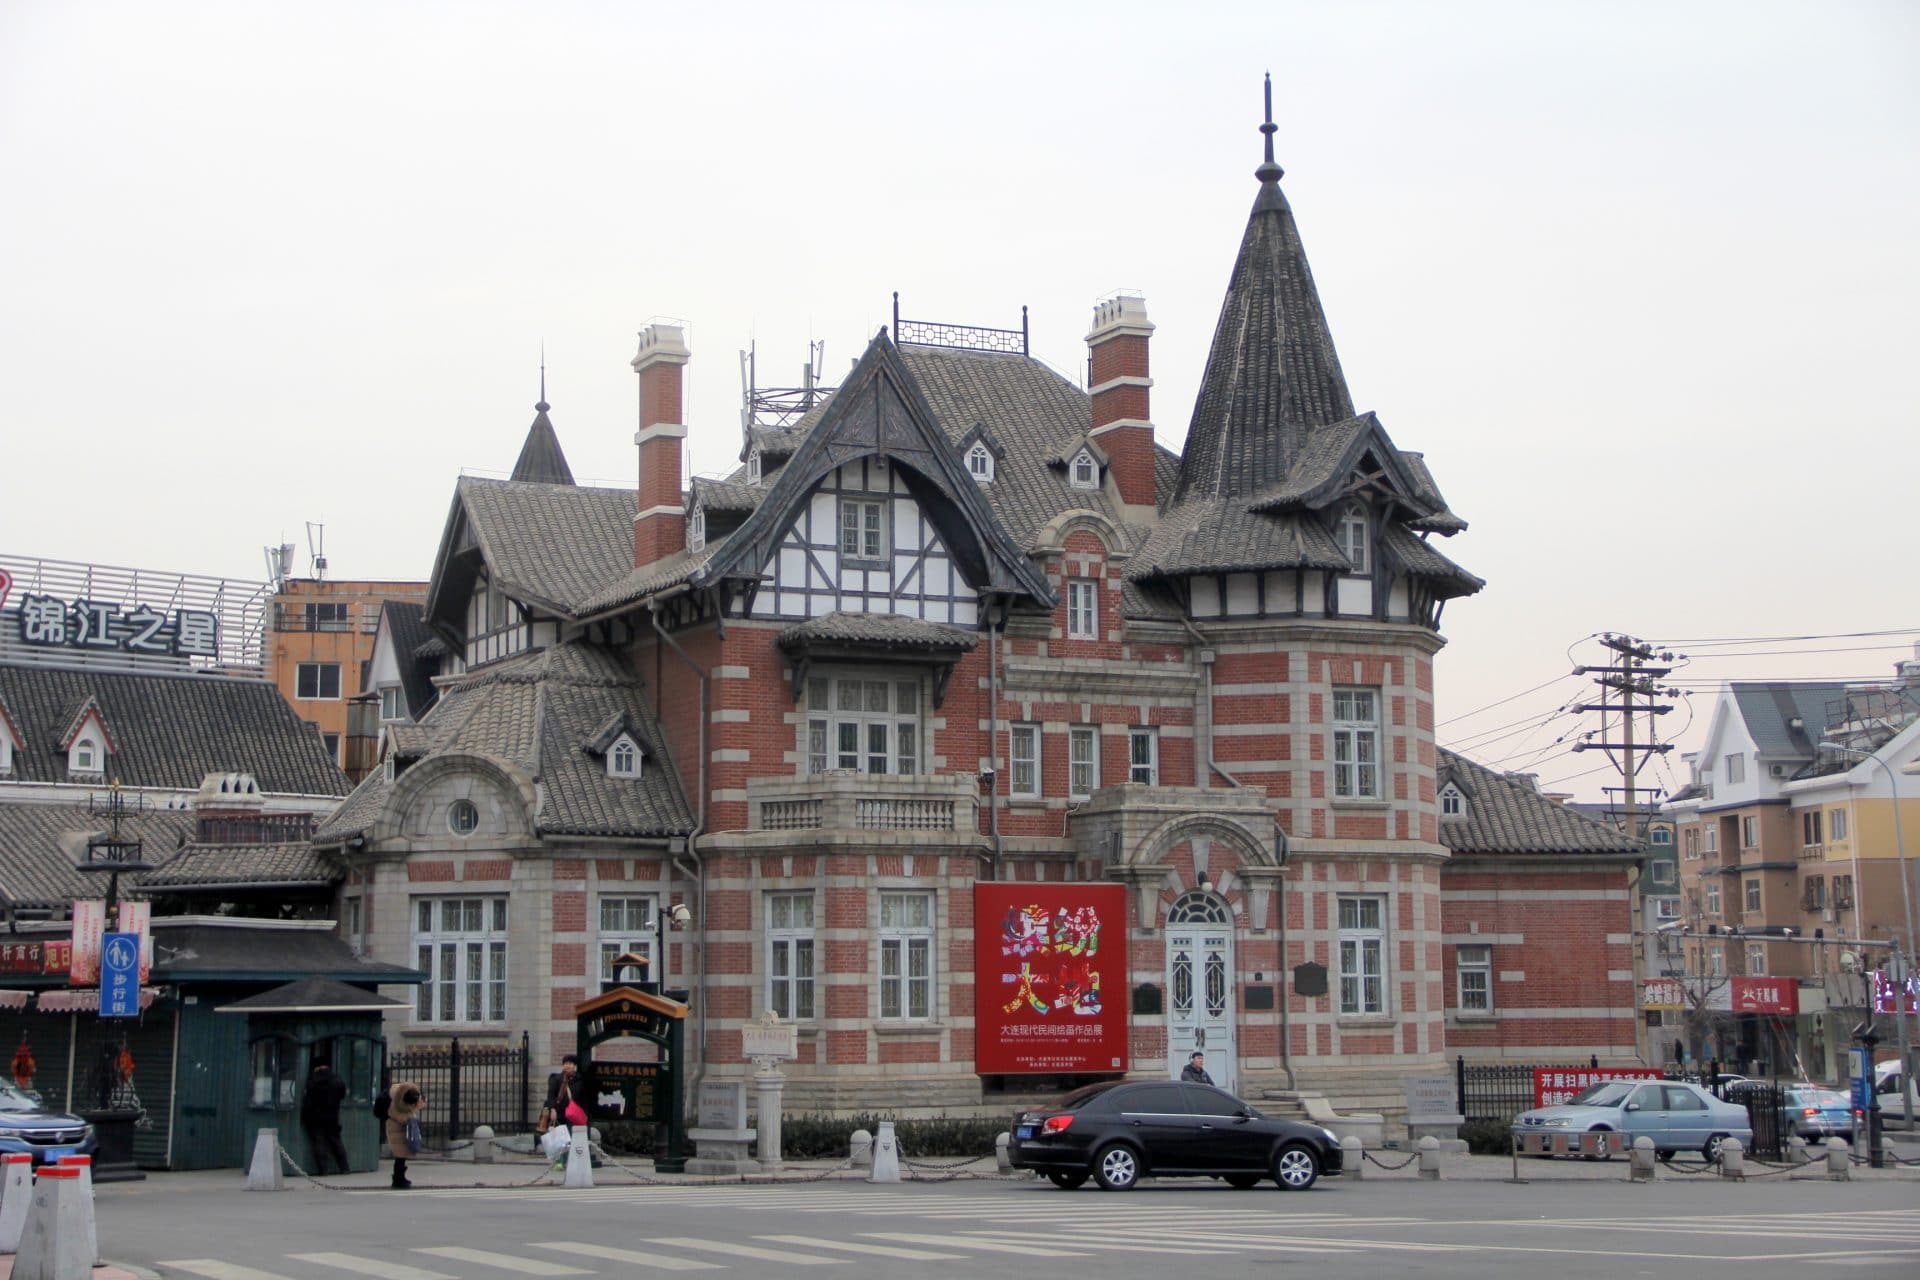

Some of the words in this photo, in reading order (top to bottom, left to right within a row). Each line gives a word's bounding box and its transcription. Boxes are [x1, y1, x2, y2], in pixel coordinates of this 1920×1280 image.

[23, 598, 218, 656] 锦江之星
[112, 974, 128, 1014] 步行街
[1001, 962, 1103, 1015] 大地
[1001, 1024, 1103, 1036] 大连现代民间绘画作品展
